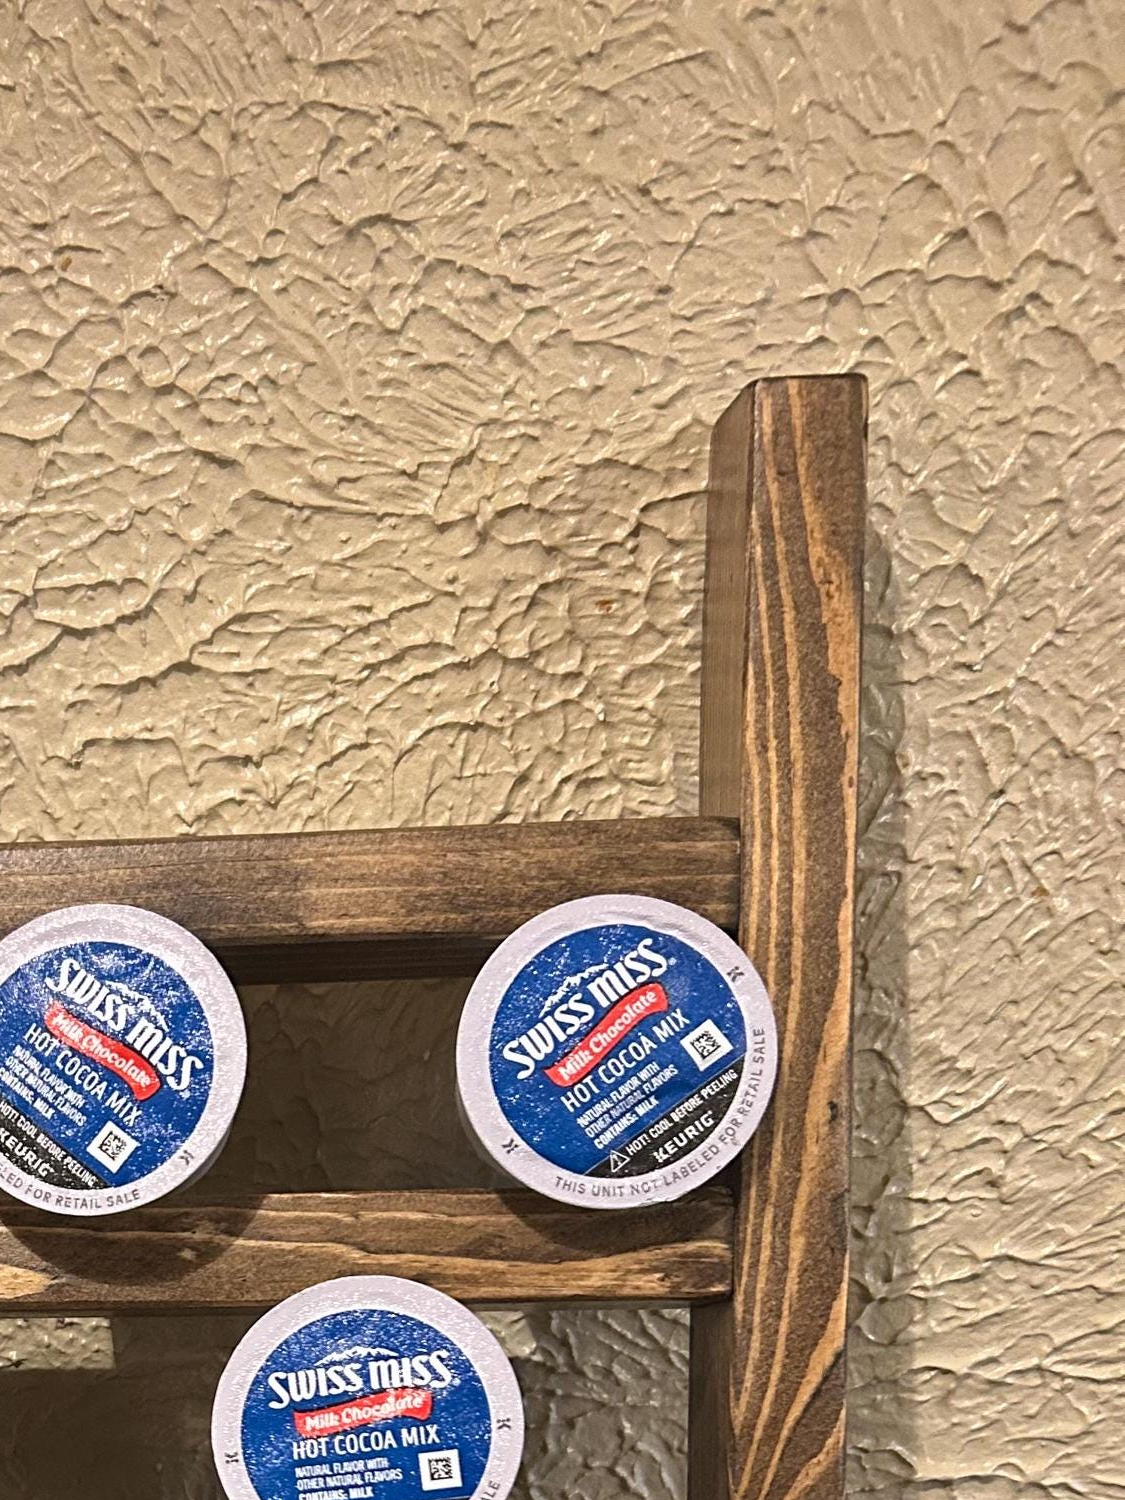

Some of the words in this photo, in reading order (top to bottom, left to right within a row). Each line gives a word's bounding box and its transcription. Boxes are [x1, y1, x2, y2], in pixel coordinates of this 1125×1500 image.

[49, 1015, 82, 1042] Milk
[81, 1037, 153, 1091] Chocolate
[501, 991, 594, 1079] SWISS
[558, 1074, 601, 1114] HOT
[595, 1036, 657, 1085] COCOA
[650, 1006, 691, 1044] MIX
[559, 1049, 593, 1082] Milk
[590, 989, 660, 1053] Chocolate
[21, 1021, 61, 1060] HOT
[54, 1049, 106, 1101] COCOA
[104, 1090, 143, 1127] MIX
[31, 1097, 56, 1121] MILK
[575, 1097, 614, 1129] NATURAL
[608, 1075, 641, 1104] FLAVOR
[634, 1060, 659, 1083] WITH
[583, 1113, 614, 1139] OTHER
[608, 1089, 646, 1120] NATURAL
[640, 1063, 678, 1096] FLAVORS
[556, 1176, 588, 1194] THIS
[592, 1185, 625, 1199] UNIT
[631, 1181, 659, 1197] NOT
[662, 1144, 720, 1186] LABELED
[718, 1116, 742, 1146] FOR
[737, 1068, 758, 1114] RETAIL
[752, 1026, 763, 1063] SALE
[592, 1110, 640, 1151] CONTAINS:
[635, 1094, 662, 1118] MILK
[627, 1133, 653, 1156] HOT!
[648, 1117, 674, 1140] COOL
[670, 1092, 706, 1123] BEFORE
[701, 1067, 737, 1099] PEELING
[14, 1116, 37, 1138] COOL
[34, 1132, 66, 1163] BEFORE
[61, 1155, 97, 1187] PEELING
[22, 1185, 51, 1204] FOR
[56, 1196, 101, 1210] RETAIL
[107, 1188, 141, 1208] SALE
[291, 1437, 329, 1460] HOT
[333, 1430, 398, 1456] COCOA
[401, 1424, 441, 1447] MIX
[304, 1411, 339, 1432] Milk
[341, 1396, 424, 1423] Chocolate
[294, 1464, 334, 1478] NATURAL
[333, 1459, 366, 1474] FLAVOR
[365, 1456, 389, 1470] WITH
[296, 1477, 326, 1491] OTHER
[325, 1473, 364, 1488] NATURAL
[364, 1467, 404, 1483] FLAVORS
[349, 1485, 375, 1499] MILK
